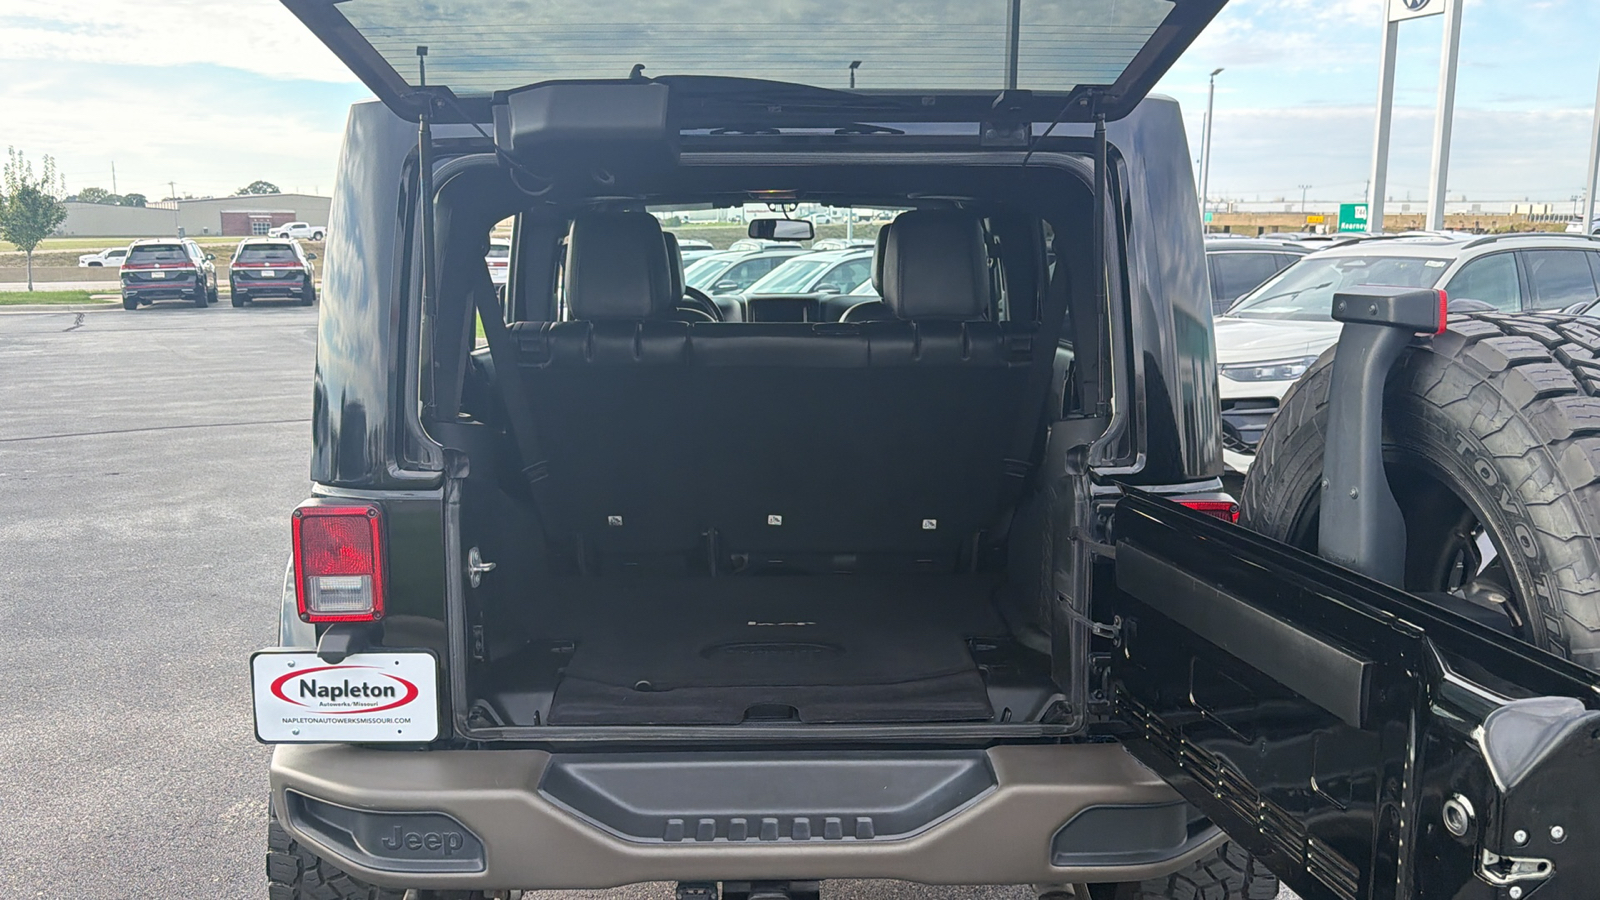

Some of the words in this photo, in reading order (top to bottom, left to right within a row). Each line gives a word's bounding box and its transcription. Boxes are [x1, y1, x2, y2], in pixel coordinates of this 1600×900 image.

[1341, 222, 1367, 230] Kearney
[1453, 430, 1538, 559] TOYO
[300, 679, 395, 701] Napleton
[381, 826, 464, 856] Jeep
